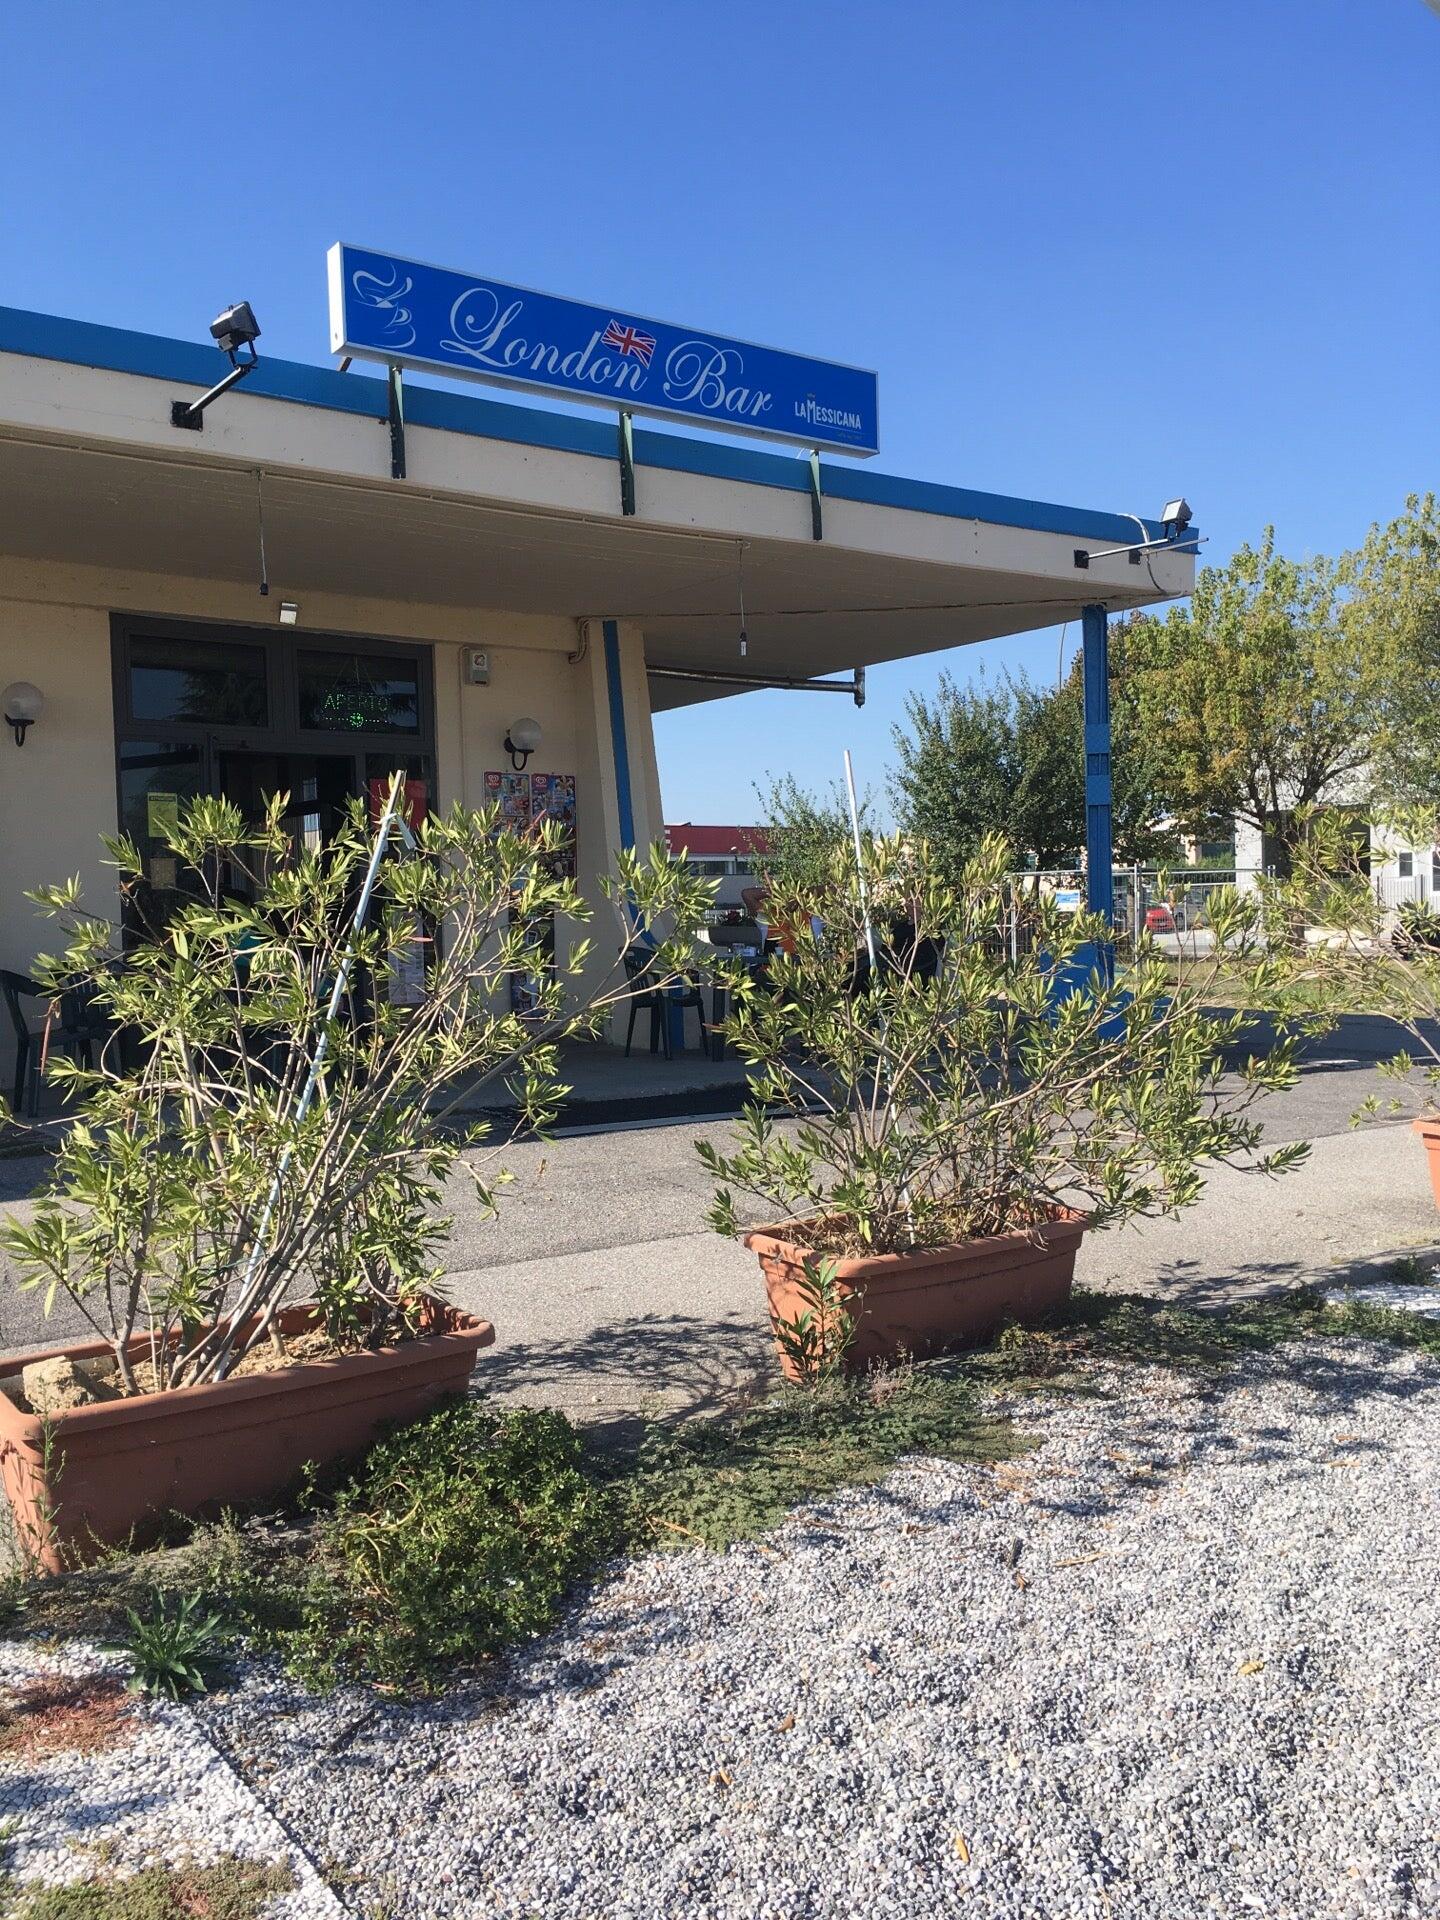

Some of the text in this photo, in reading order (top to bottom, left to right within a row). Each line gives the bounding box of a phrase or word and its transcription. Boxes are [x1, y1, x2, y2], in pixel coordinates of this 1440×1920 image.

[439, 287, 773, 416] London Bar
[324, 693, 389, 712] APERTO
